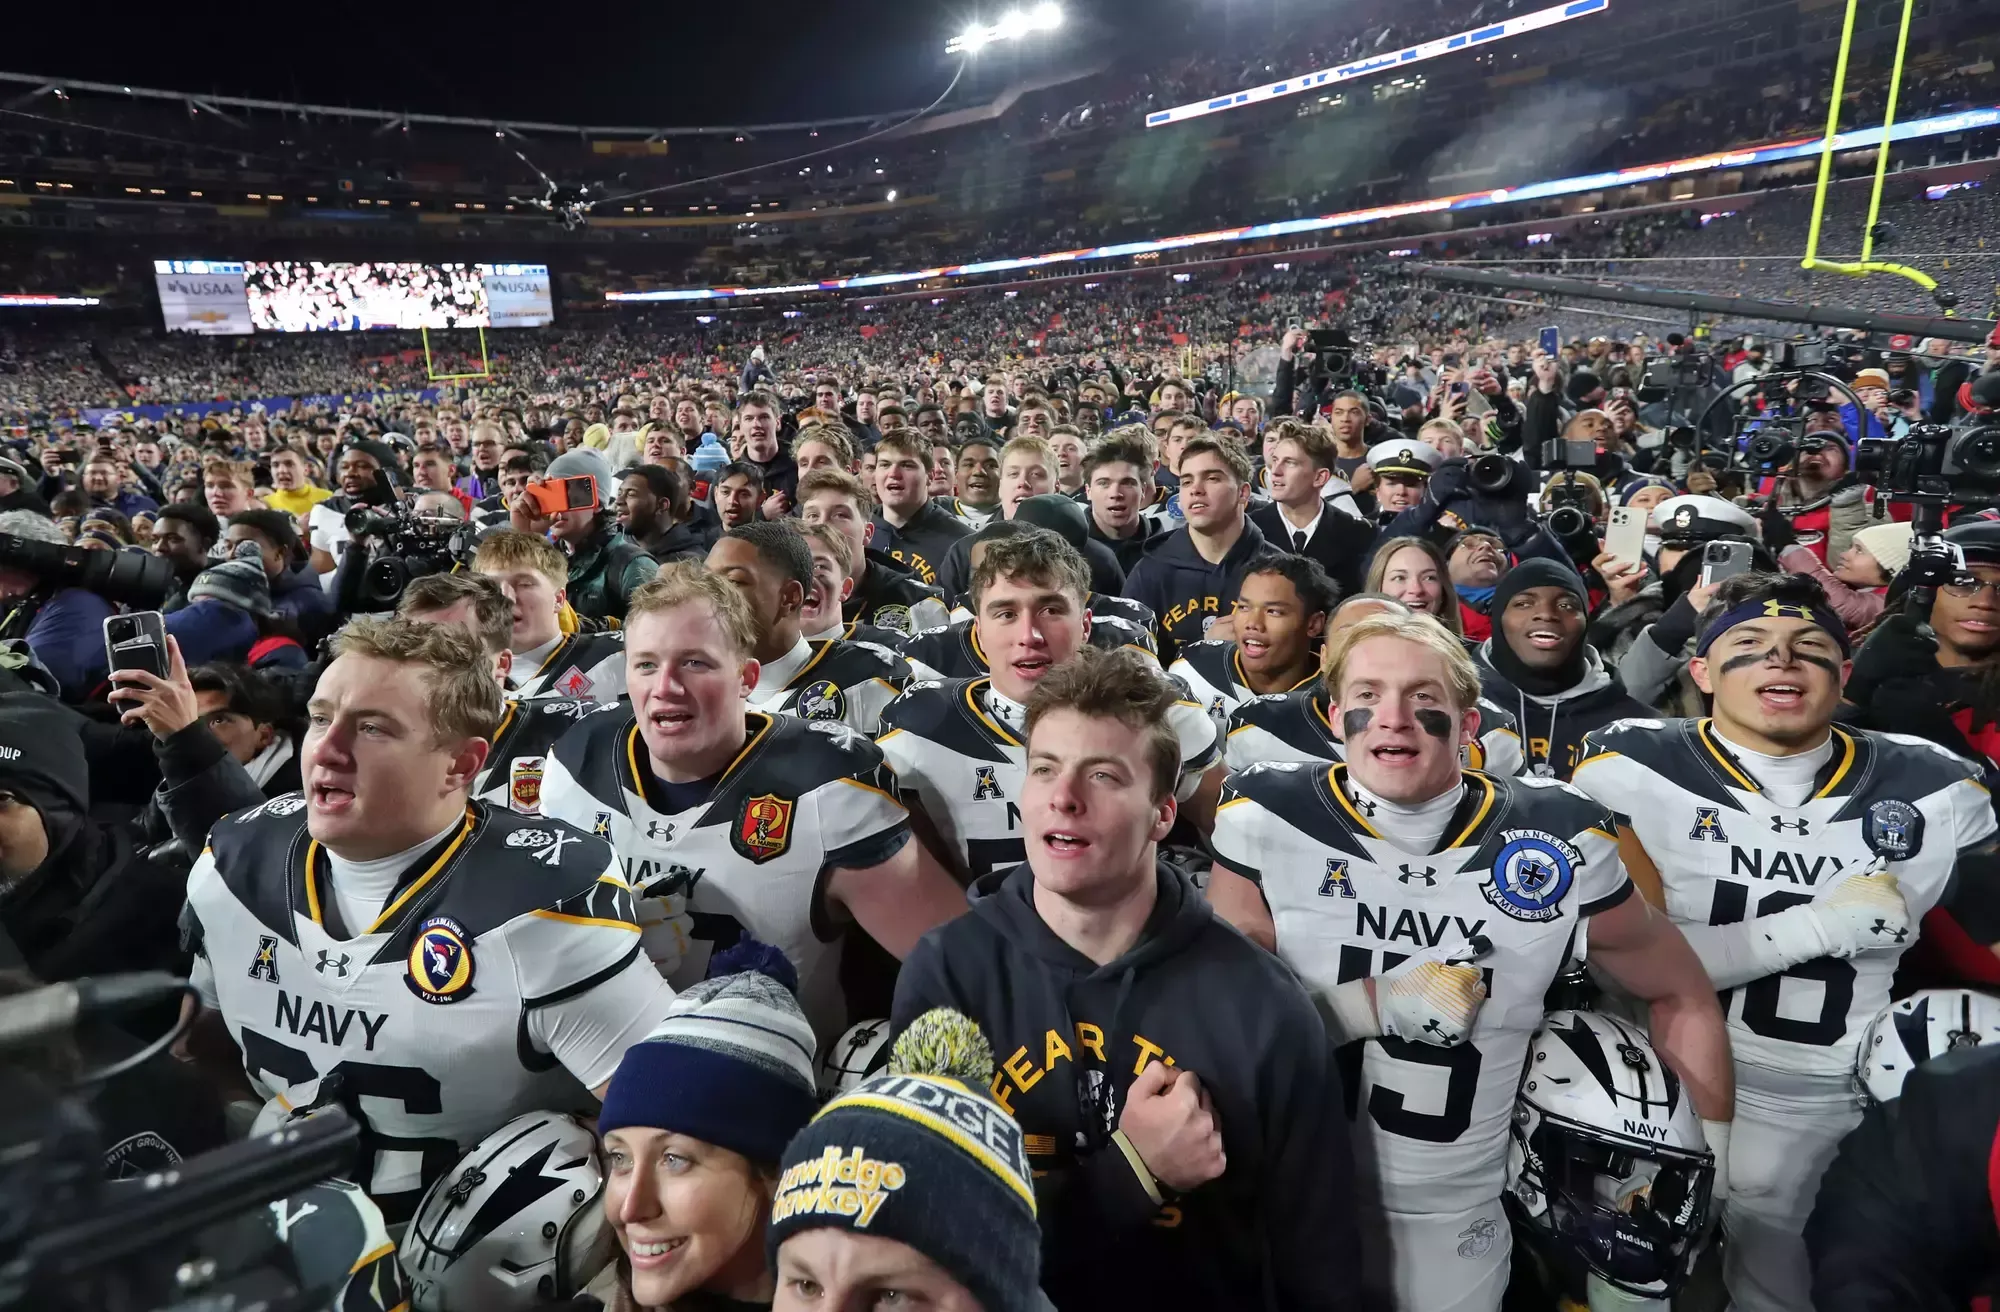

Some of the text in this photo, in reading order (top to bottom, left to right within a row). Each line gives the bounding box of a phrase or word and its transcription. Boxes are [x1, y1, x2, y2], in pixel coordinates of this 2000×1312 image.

[190, 281, 233, 296] USAA
[508, 282, 540, 293] USAA
[1162, 596, 1219, 632] FEAR
[973, 765, 1005, 801] A
[1689, 806, 1728, 844] A
[1512, 830, 1573, 858] LANCERS
[1318, 858, 1357, 899] A
[1492, 890, 1550, 919] VMFA-212
[1356, 902, 1487, 948] NAVY
[248, 934, 281, 985] A
[275, 989, 390, 1052] NAVY
[989, 1021, 1107, 1116] FEAR
[136, 1137, 166, 1150] GROUP
[1623, 1118, 1668, 1142] NAVY
[1615, 1229, 1653, 1251] Riddell
